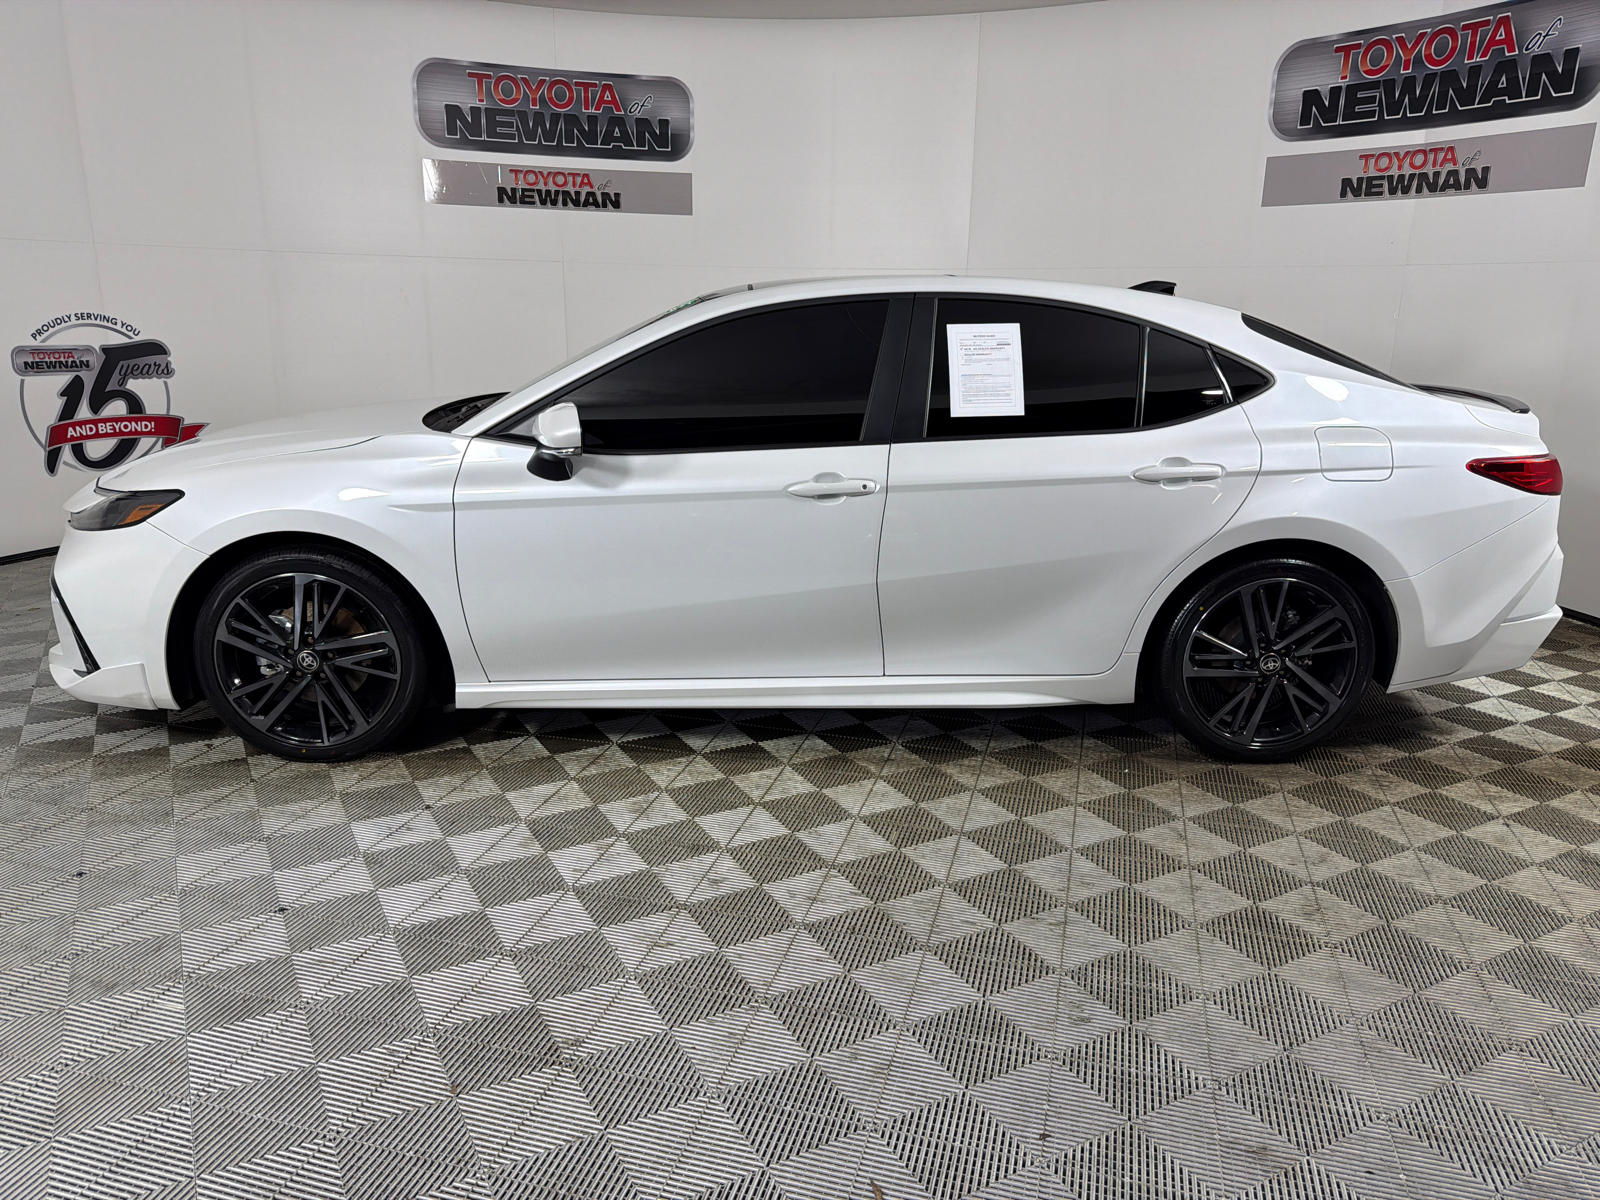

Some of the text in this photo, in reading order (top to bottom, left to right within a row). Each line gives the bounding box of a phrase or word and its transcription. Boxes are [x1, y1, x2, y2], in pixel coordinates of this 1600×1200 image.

[1334, 12, 1563, 82] TOYOTA of
[466, 70, 653, 116] TOYOTA of
[1297, 44, 1583, 129] NEWNAN
[444, 103, 671, 151] NEWNAN
[1359, 145, 1481, 174] TOYOTA of
[508, 168, 612, 191] TOYOTA of
[1339, 165, 1491, 200] NEWNAN
[496, 186, 622, 210] NEWNAN
[30, 312, 141, 341] PROUDLY SERVING YOU
[23, 360, 90, 370] NEWNAN
[29, 351, 76, 360] TOYOTA
[46, 340, 173, 475] 15 years
[67, 421, 155, 438] AND BEYOND!
